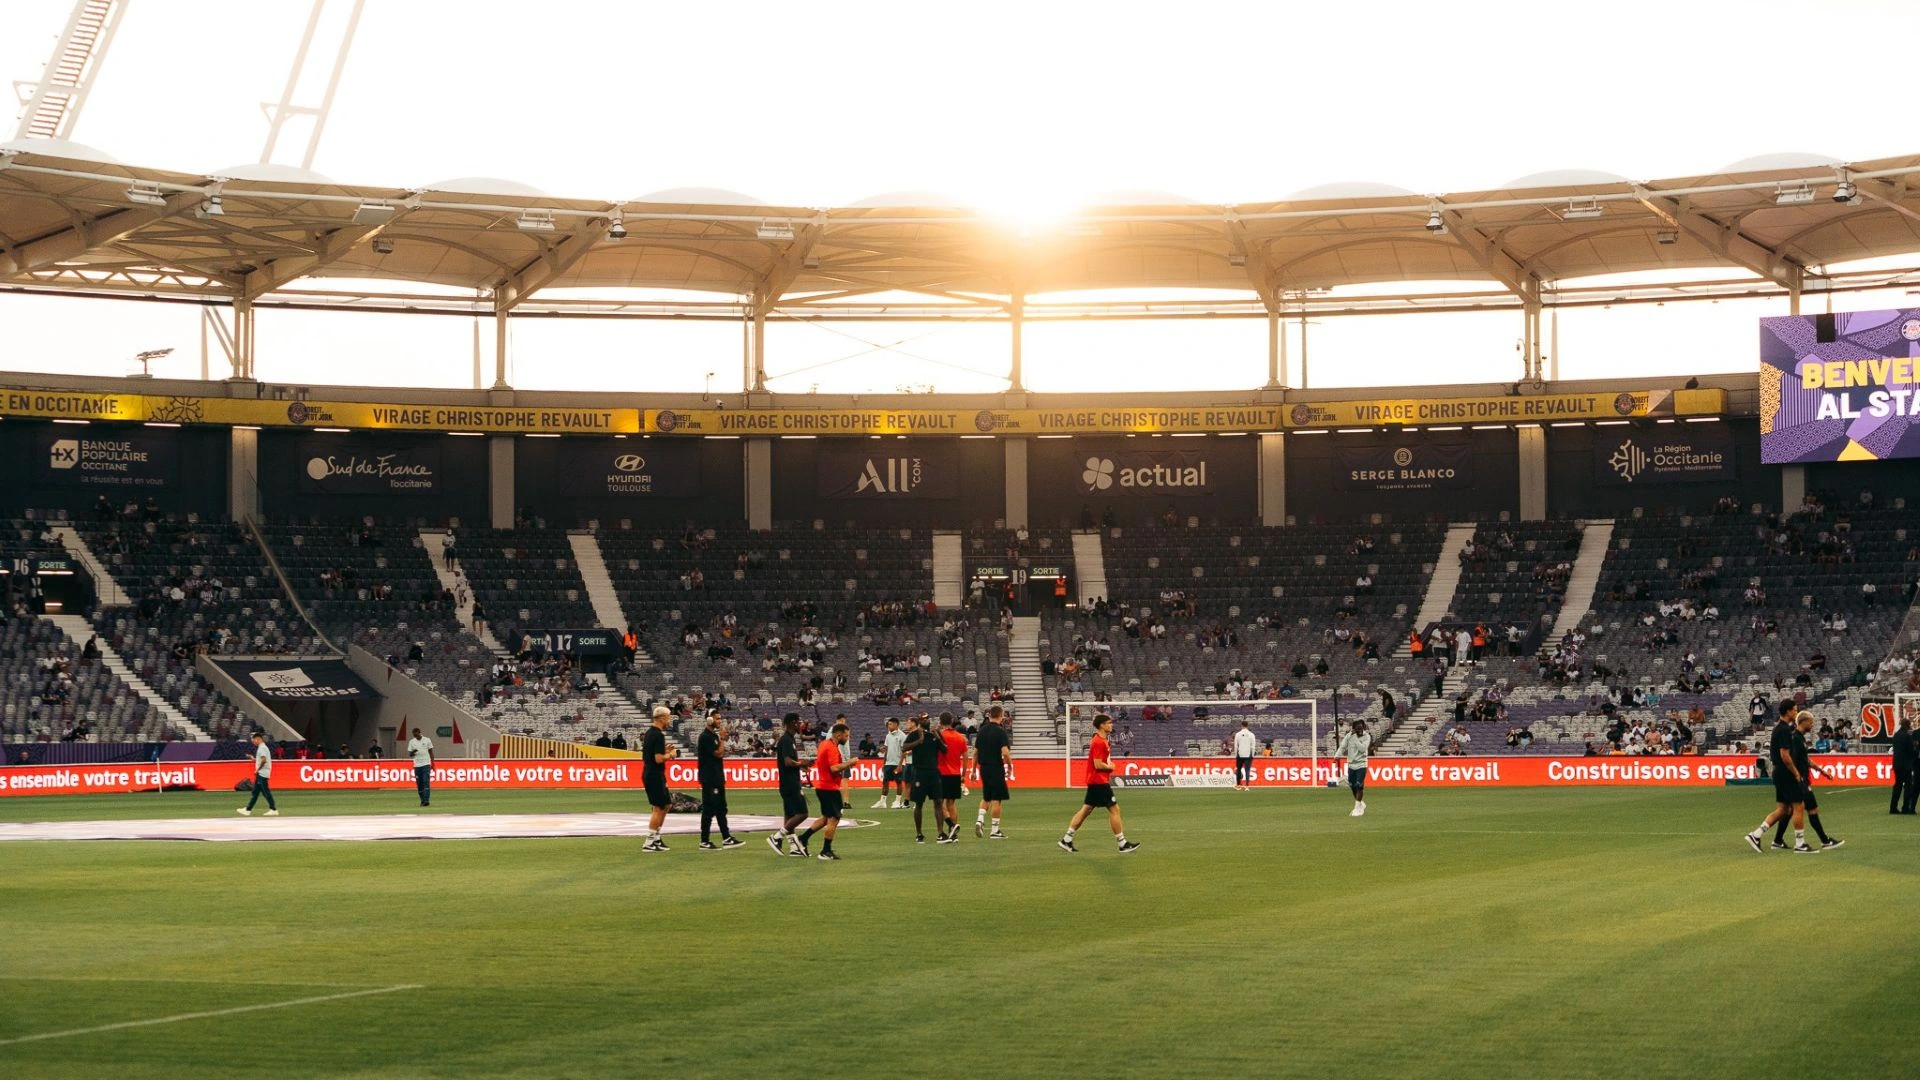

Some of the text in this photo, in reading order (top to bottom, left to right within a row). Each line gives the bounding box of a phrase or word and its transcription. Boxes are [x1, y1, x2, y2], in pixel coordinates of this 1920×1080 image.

[9, 395, 30, 410] EN
[35, 396, 124, 414] OCCITANIE.
[1355, 397, 1597, 420] VIRAGE CHRISTOPHE REVAULT
[1817, 392, 1861, 420] AL
[373, 408, 612, 428] VIRAGE CHRISTOPHE REVAULT
[720, 414, 956, 429] VIRAGE CHRISTOPHE REVAULT
[1038, 410, 1276, 428] VIRAGE CHRISTOPHE REVAULT
[81, 440, 132, 452] BANQUE
[1654, 445, 1692, 455] La Région
[81, 450, 148, 462] POPULAIRE
[1654, 451, 1722, 466] Occitanie
[81, 462, 128, 472] OCCITANE
[327, 454, 433, 478] Sud de France
[1120, 461, 1206, 488] actual
[1351, 468, 1455, 480] SERGE BLANCO
[607, 474, 652, 484] HYUNDAI
[607, 484, 652, 493] TOULOUSE
[13, 558, 30, 575] 16
[39, 561, 67, 569] SORTIE
[977, 567, 1060, 585] SORTIE 19 SORTIE
[556, 634, 607, 651] 17 SORTIE
[262, 687, 361, 697] TOULOUSE
[10, 770, 79, 789] ensemble
[84, 770, 129, 786] votre
[134, 767, 196, 785] travail
[515, 766, 563, 782] votre
[568, 764, 628, 782] travail
[669, 764, 780, 782] Coruison
[1264, 762, 1349, 781] ensembl
[1368, 763, 1424, 781] votre
[1430, 762, 1500, 781] travail
[1548, 761, 1691, 780] Construisons
